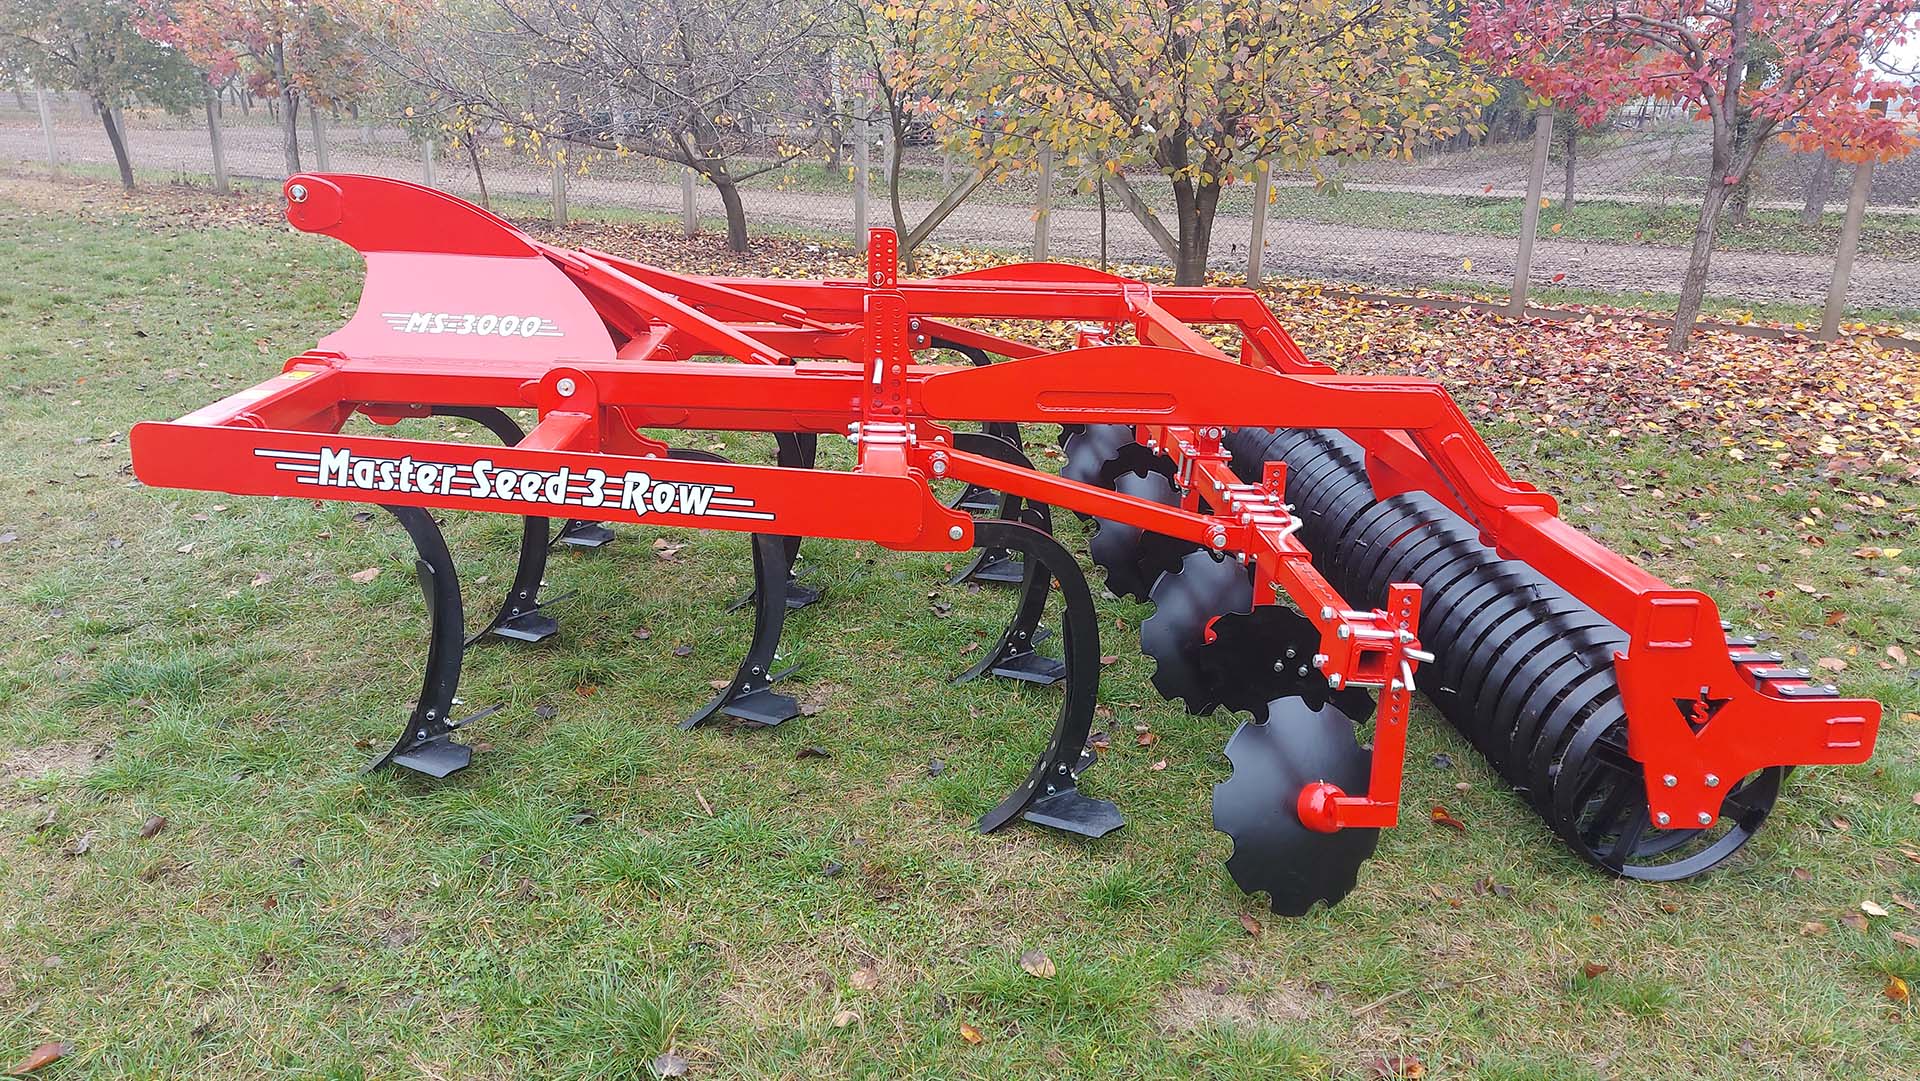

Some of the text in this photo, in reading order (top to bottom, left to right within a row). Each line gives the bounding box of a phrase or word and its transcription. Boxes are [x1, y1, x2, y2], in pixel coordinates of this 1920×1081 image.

[456, 313, 541, 337] 3000
[319, 447, 715, 516] Master Seed 3 Row
